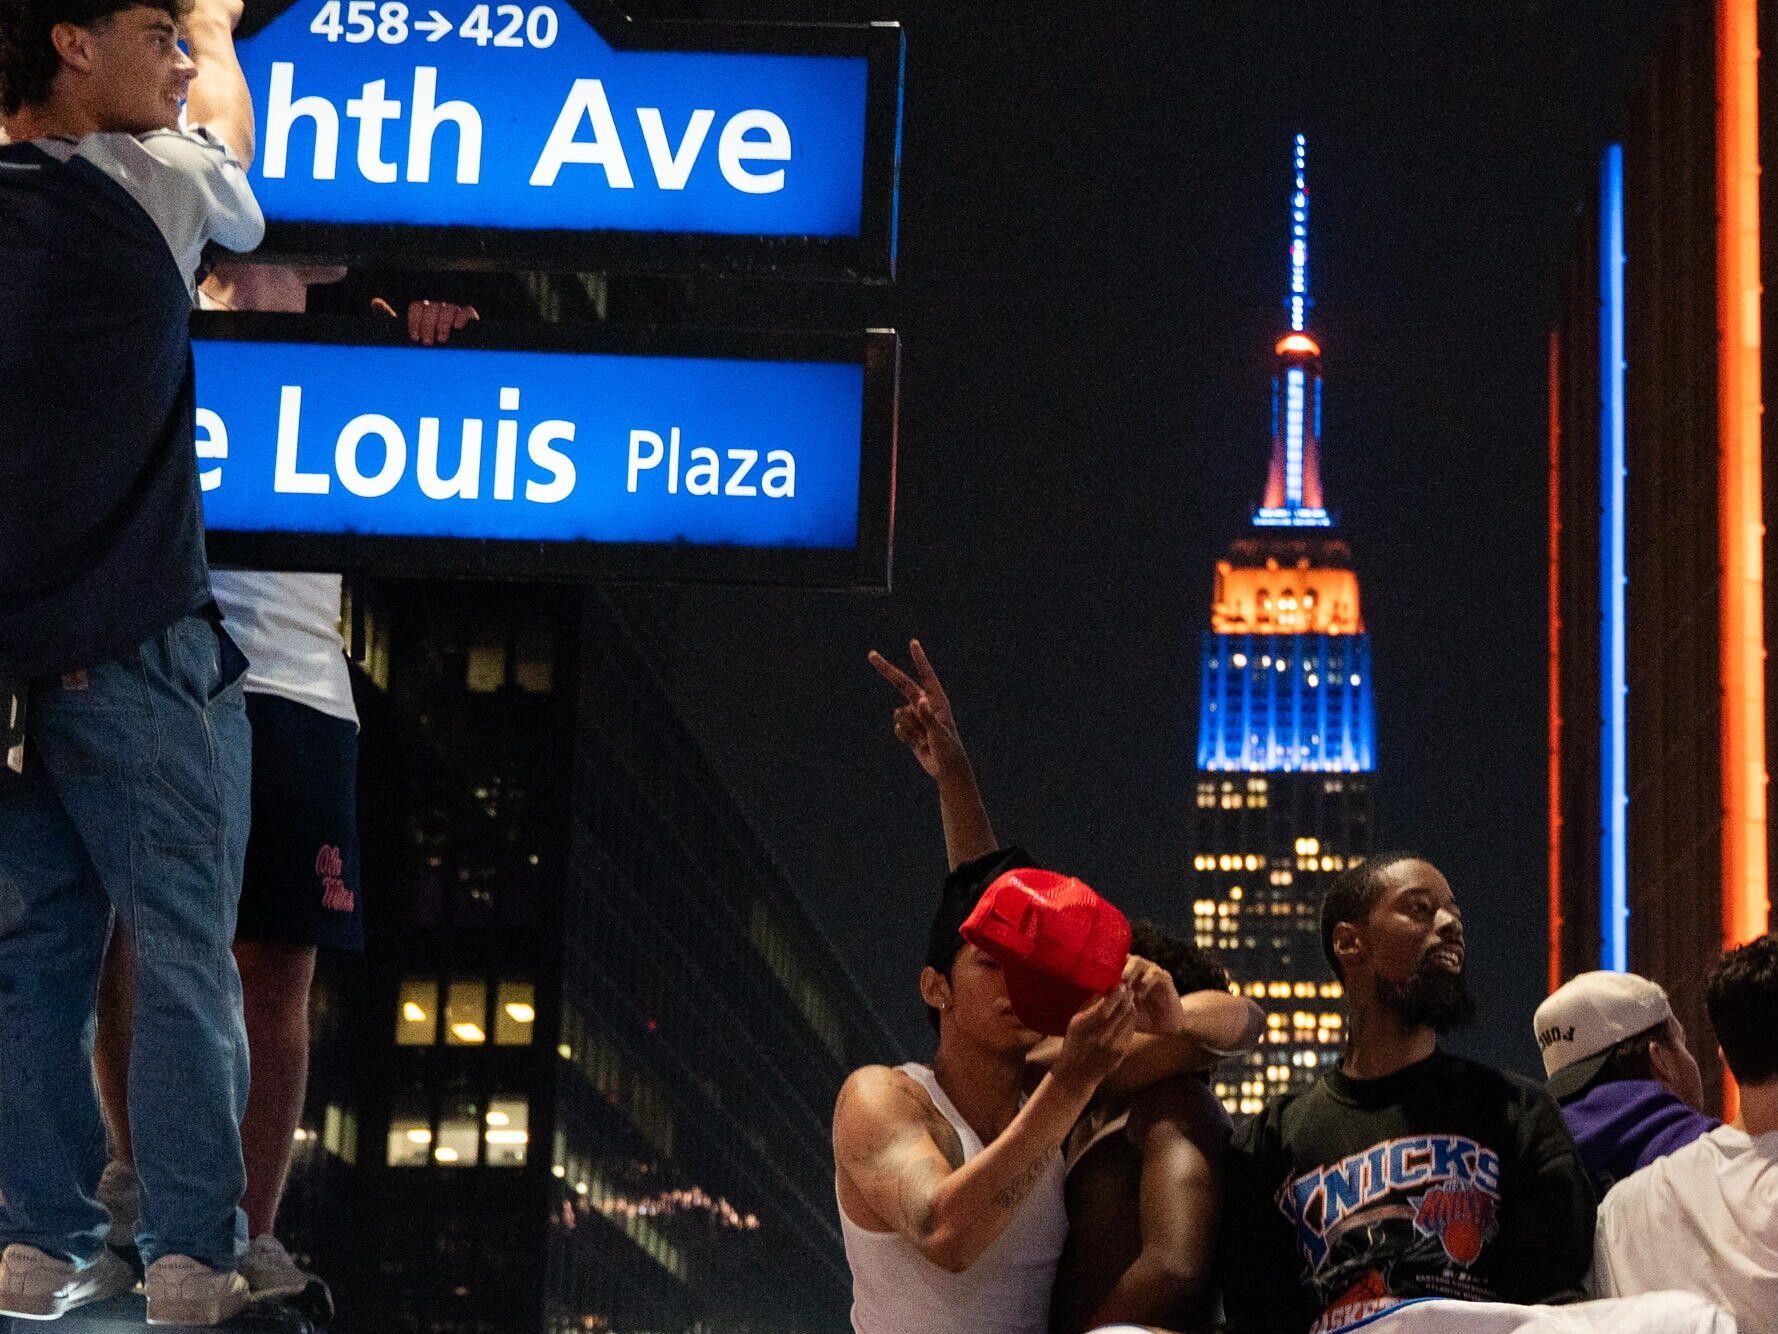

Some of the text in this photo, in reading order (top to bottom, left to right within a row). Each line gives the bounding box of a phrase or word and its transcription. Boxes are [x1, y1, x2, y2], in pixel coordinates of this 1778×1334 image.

[310, 3, 558, 49] 458 420
[529, 78, 792, 194] Ave
[272, 385, 577, 504] Louis
[625, 427, 796, 499] Plaza
